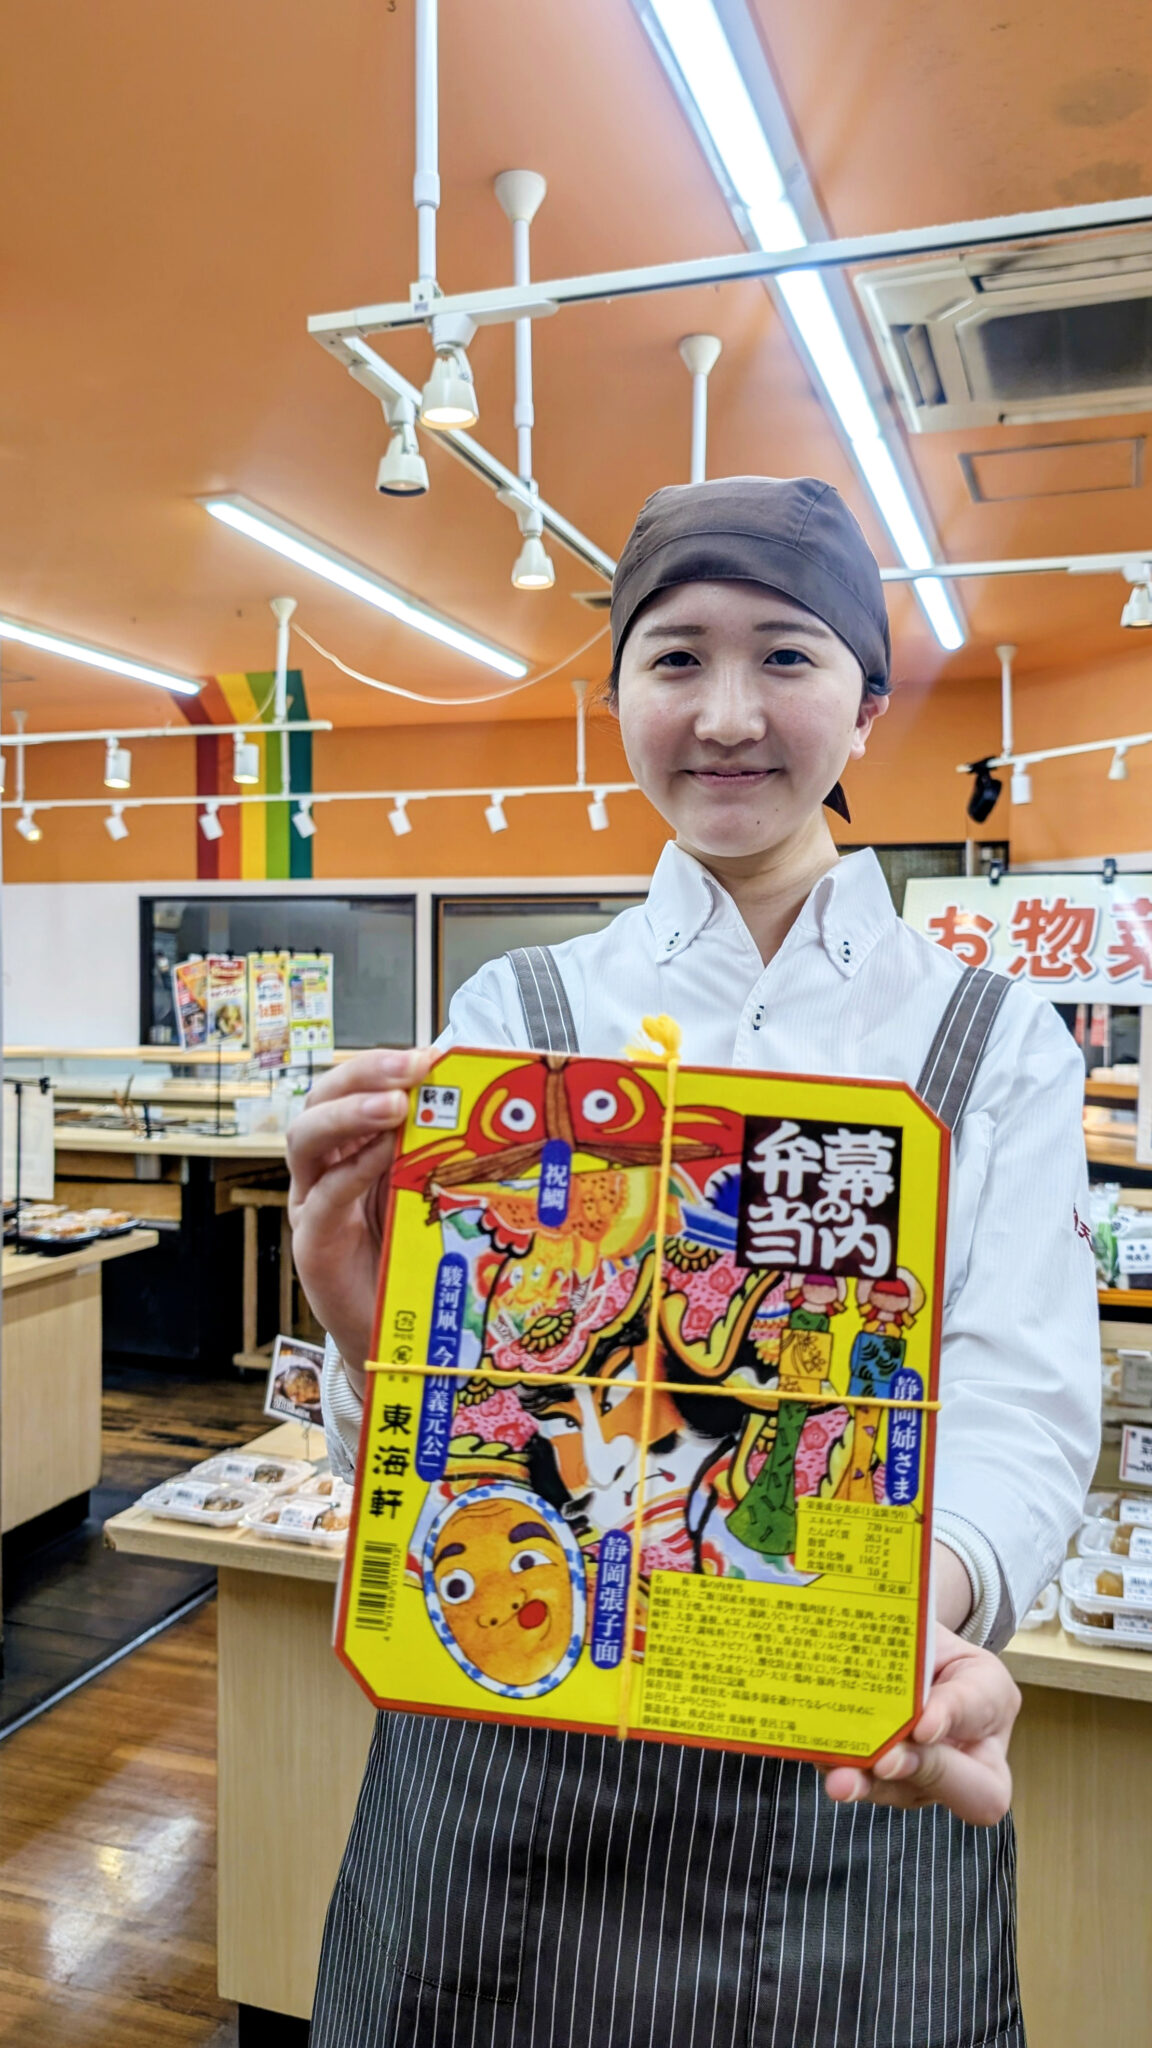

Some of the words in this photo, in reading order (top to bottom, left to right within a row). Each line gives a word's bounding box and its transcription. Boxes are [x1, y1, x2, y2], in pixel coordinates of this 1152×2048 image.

[541, 1163, 568, 1211] 祝鯛
[745, 1120, 823, 1266] 弁当
[812, 1128, 896, 1278] 幕の内
[369, 1403, 412, 1520] 東海軒
[594, 1536, 630, 1664] 静岡張子面
